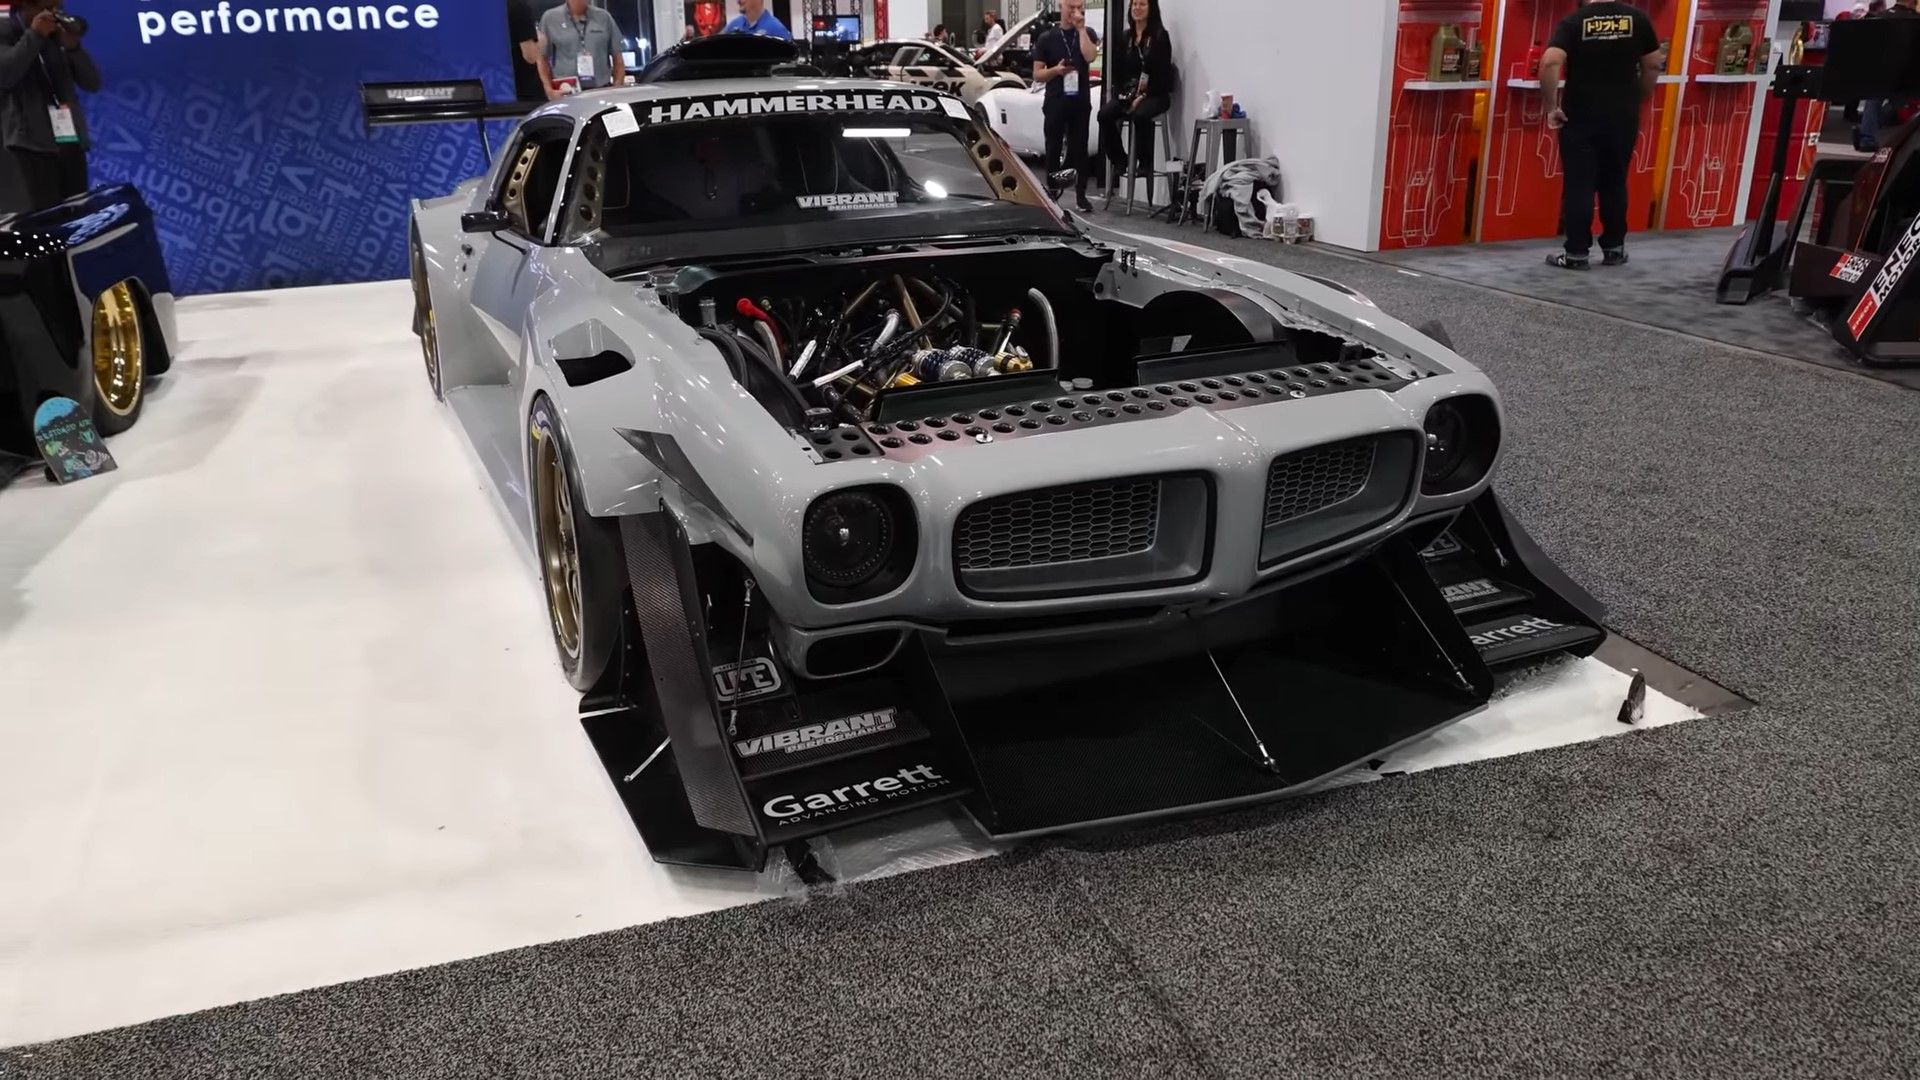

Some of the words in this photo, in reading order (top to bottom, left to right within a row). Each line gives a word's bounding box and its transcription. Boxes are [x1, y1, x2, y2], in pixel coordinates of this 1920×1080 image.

[137, 1, 440, 44] performance
[386, 87, 456, 99] VIBRANT
[648, 94, 938, 124] HAMMERHEAD
[796, 191, 899, 209] VIBRANT
[827, 202, 898, 212] PERFORMANCE
[1469, 616, 1565, 646] arrett
[734, 708, 897, 757] VIBRANT
[785, 722, 897, 754] PERFORMANCE
[762, 764, 943, 819] Garrett
[778, 797, 880, 827] ADVANCING
[886, 779, 952, 800] MOTION
